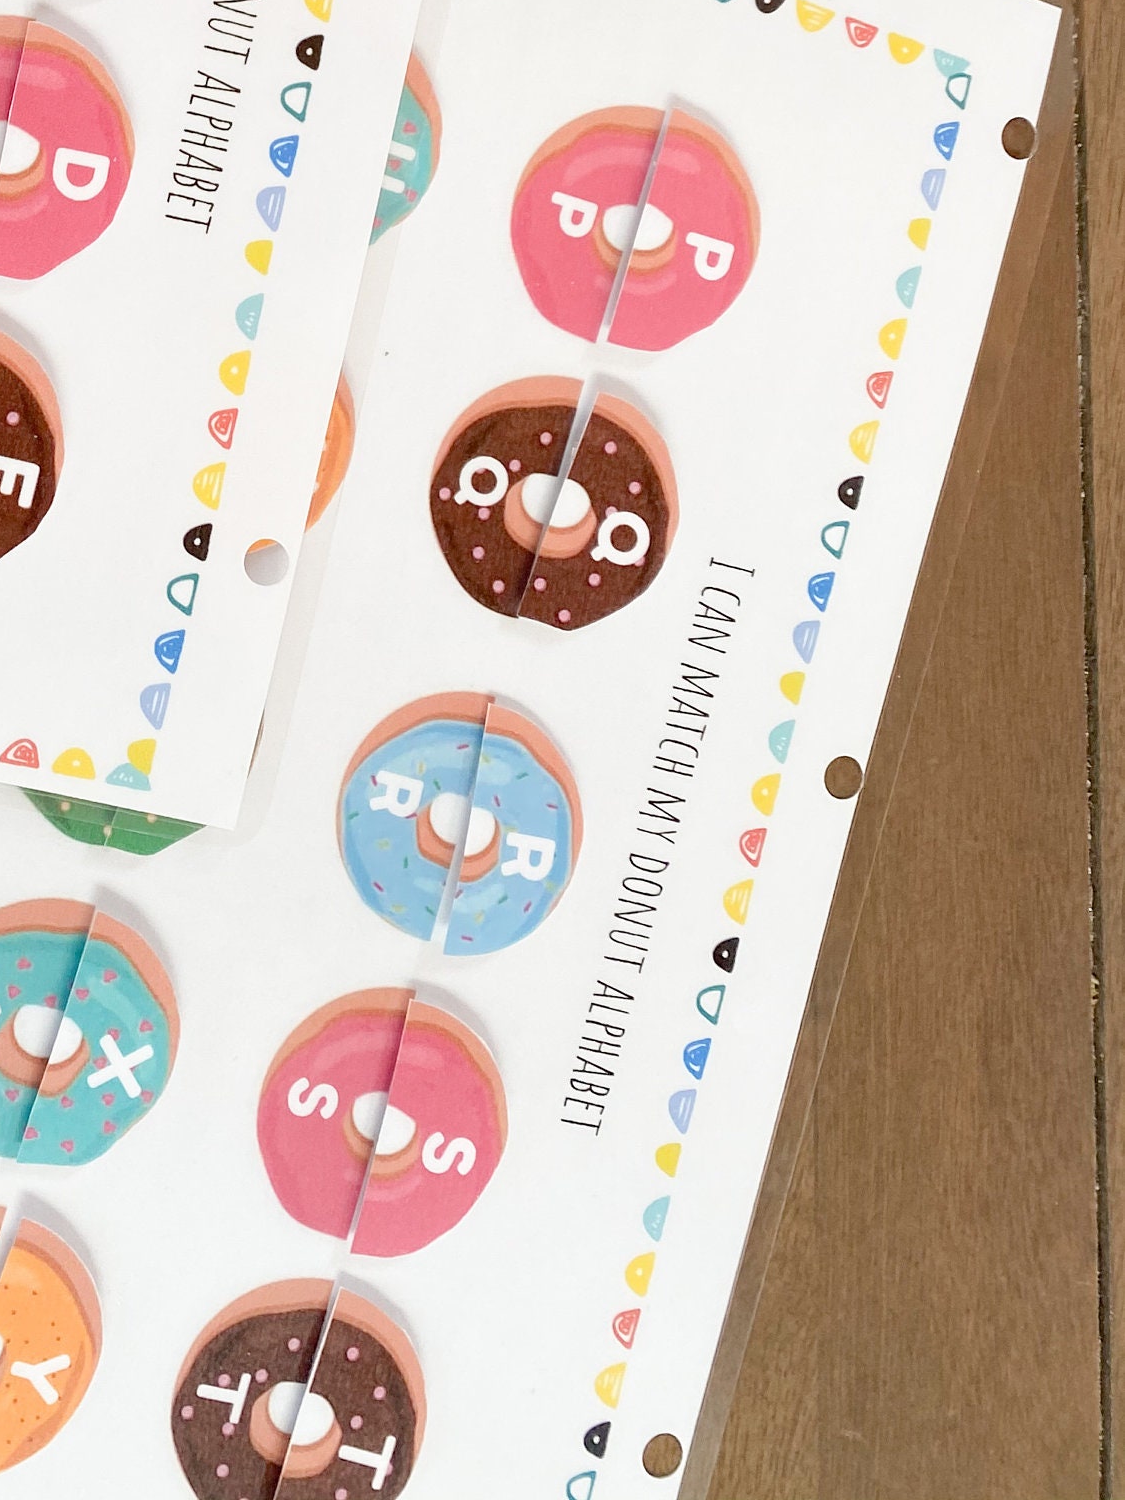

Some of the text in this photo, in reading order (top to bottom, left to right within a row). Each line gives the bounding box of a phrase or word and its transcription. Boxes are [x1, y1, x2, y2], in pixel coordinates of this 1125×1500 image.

[52, 147, 111, 201] D
[165, 70, 241, 234] ALPHABET
[551, 191, 599, 238] P
[685, 231, 735, 281] P
[453, 455, 509, 507] Q
[590, 506, 651, 566] Q
[369, 769, 424, 818] R
[500, 831, 556, 881] R
[560, 557, 755, 1136] I CAN MATCH MY DONUT ALPHABET
[88, 1034, 153, 1098] X
[287, 1077, 339, 1120] S
[421, 1131, 477, 1176] S
[10, 1354, 71, 1405] Y
[196, 1372, 252, 1424] T
[337, 1434, 397, 1491] T
